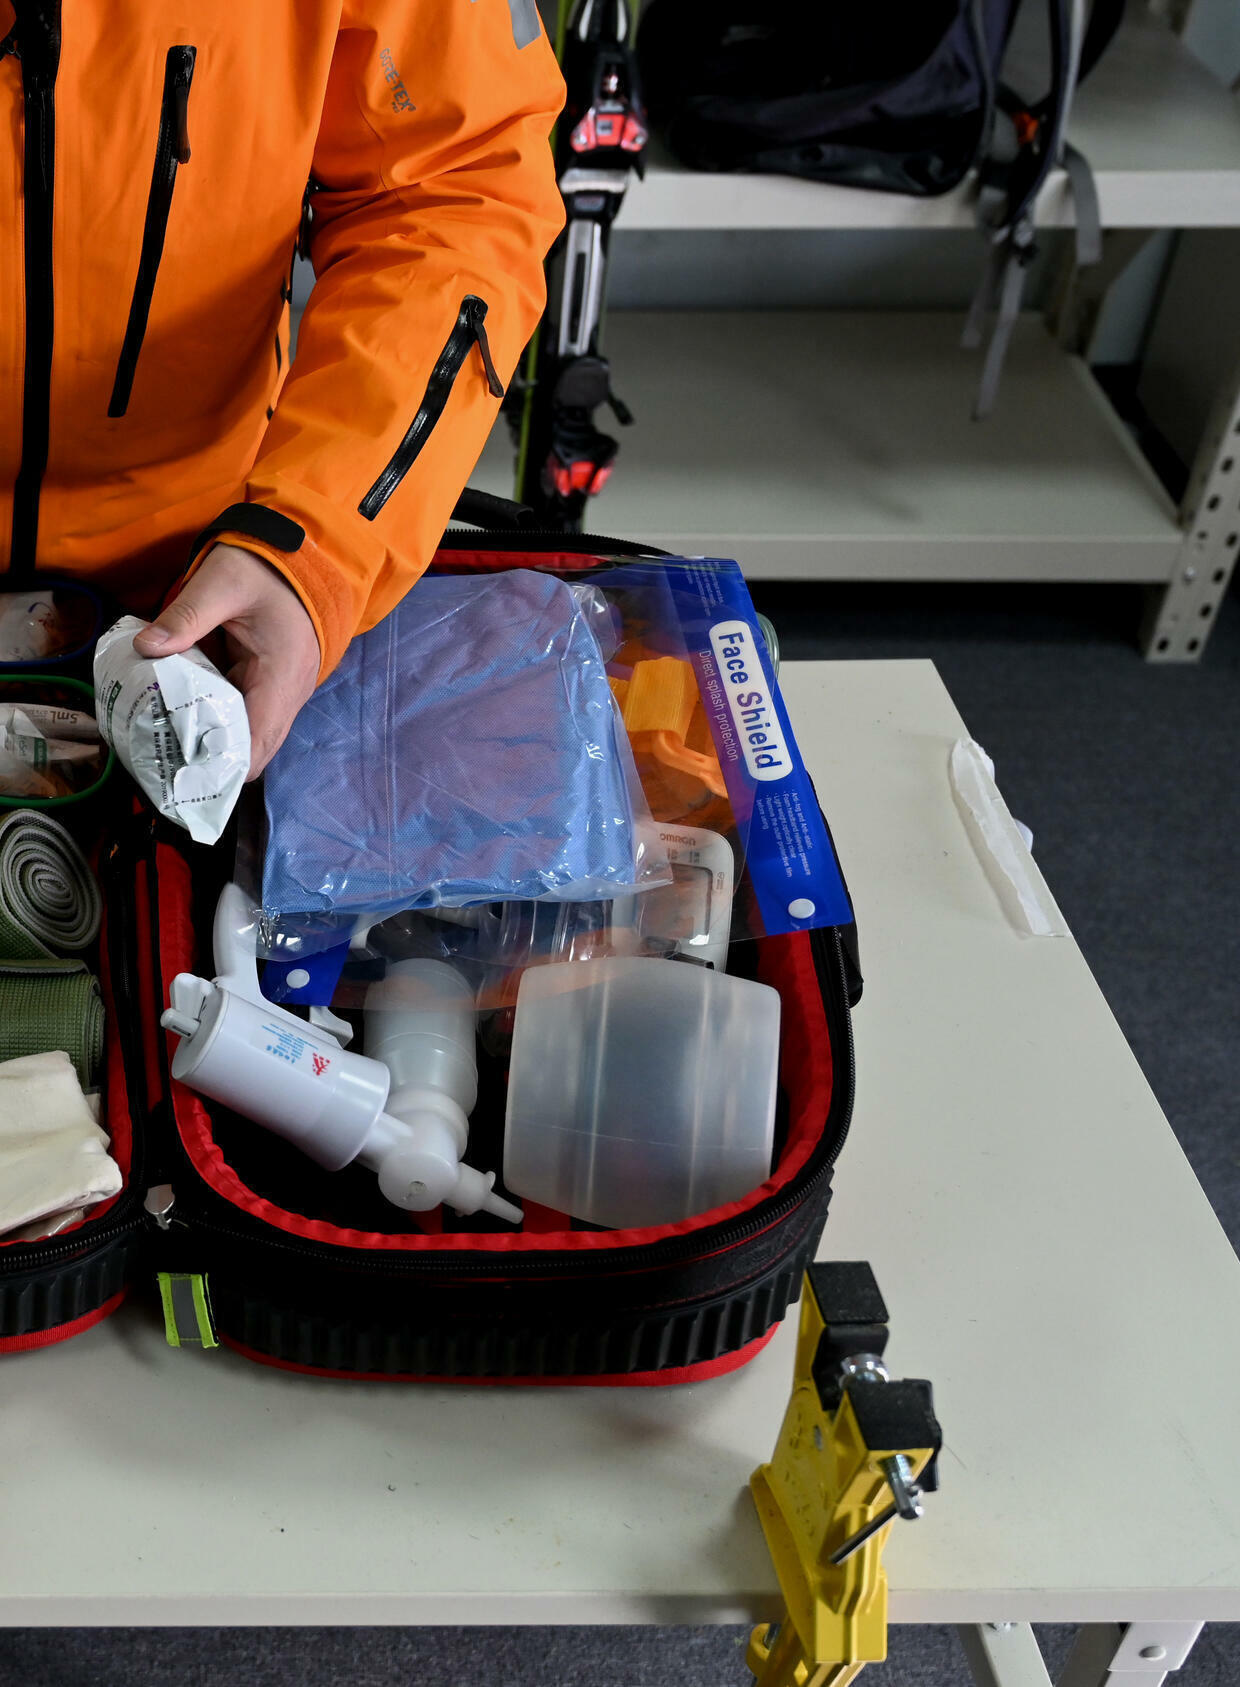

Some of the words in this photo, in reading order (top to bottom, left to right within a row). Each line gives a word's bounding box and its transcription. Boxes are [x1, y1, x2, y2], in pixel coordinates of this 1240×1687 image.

[698, 650, 713, 678] Direct
[704, 678, 725, 711] splash
[717, 631, 749, 685] Face
[736, 691, 782, 769] Shield
[714, 712, 739, 762] protection
